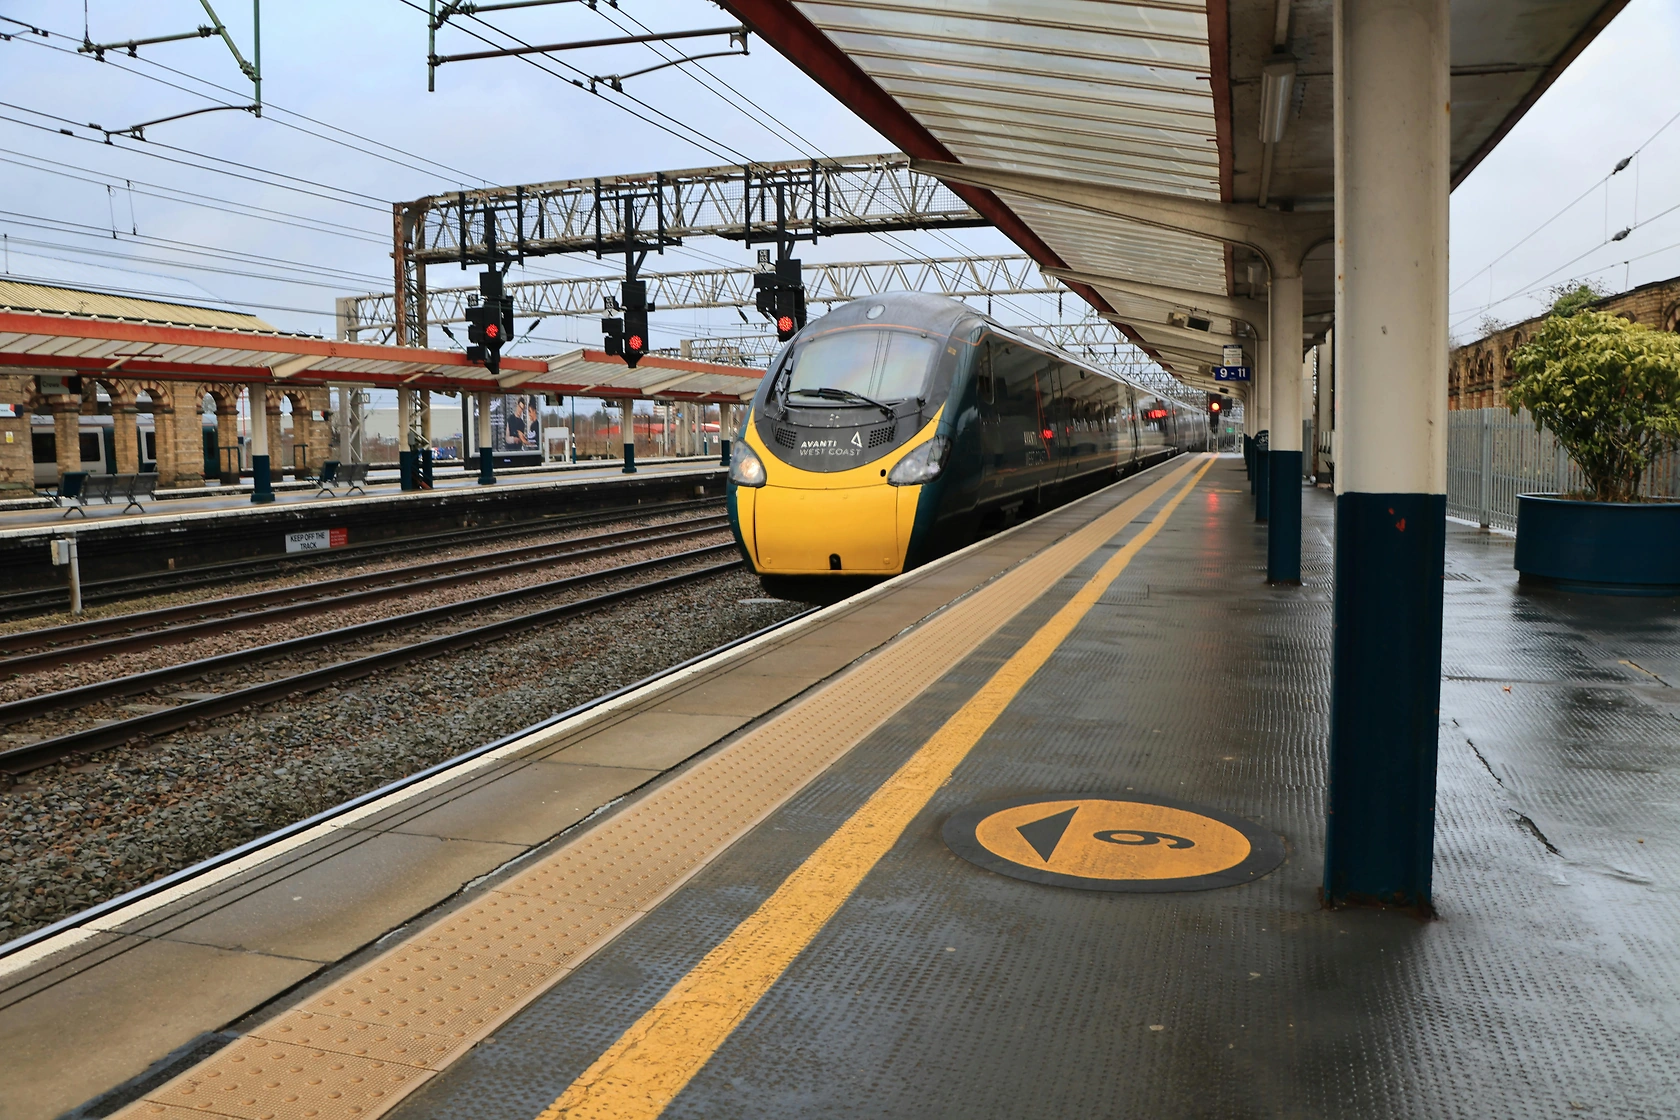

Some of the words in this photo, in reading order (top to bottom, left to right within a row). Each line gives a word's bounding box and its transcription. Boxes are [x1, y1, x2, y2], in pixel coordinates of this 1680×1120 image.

[1220, 368, 1227, 378] 9
[1238, 368, 1246, 377] 11
[361, 394, 369, 402] 10
[800, 440, 837, 448] AVANTI
[799, 448, 825, 456] WEST
[828, 448, 862, 456] COAST
[290, 534, 304, 542] KEEP
[305, 533, 315, 541] OFF
[300, 542, 318, 550] TRACK
[1093, 829, 1195, 849] 9
